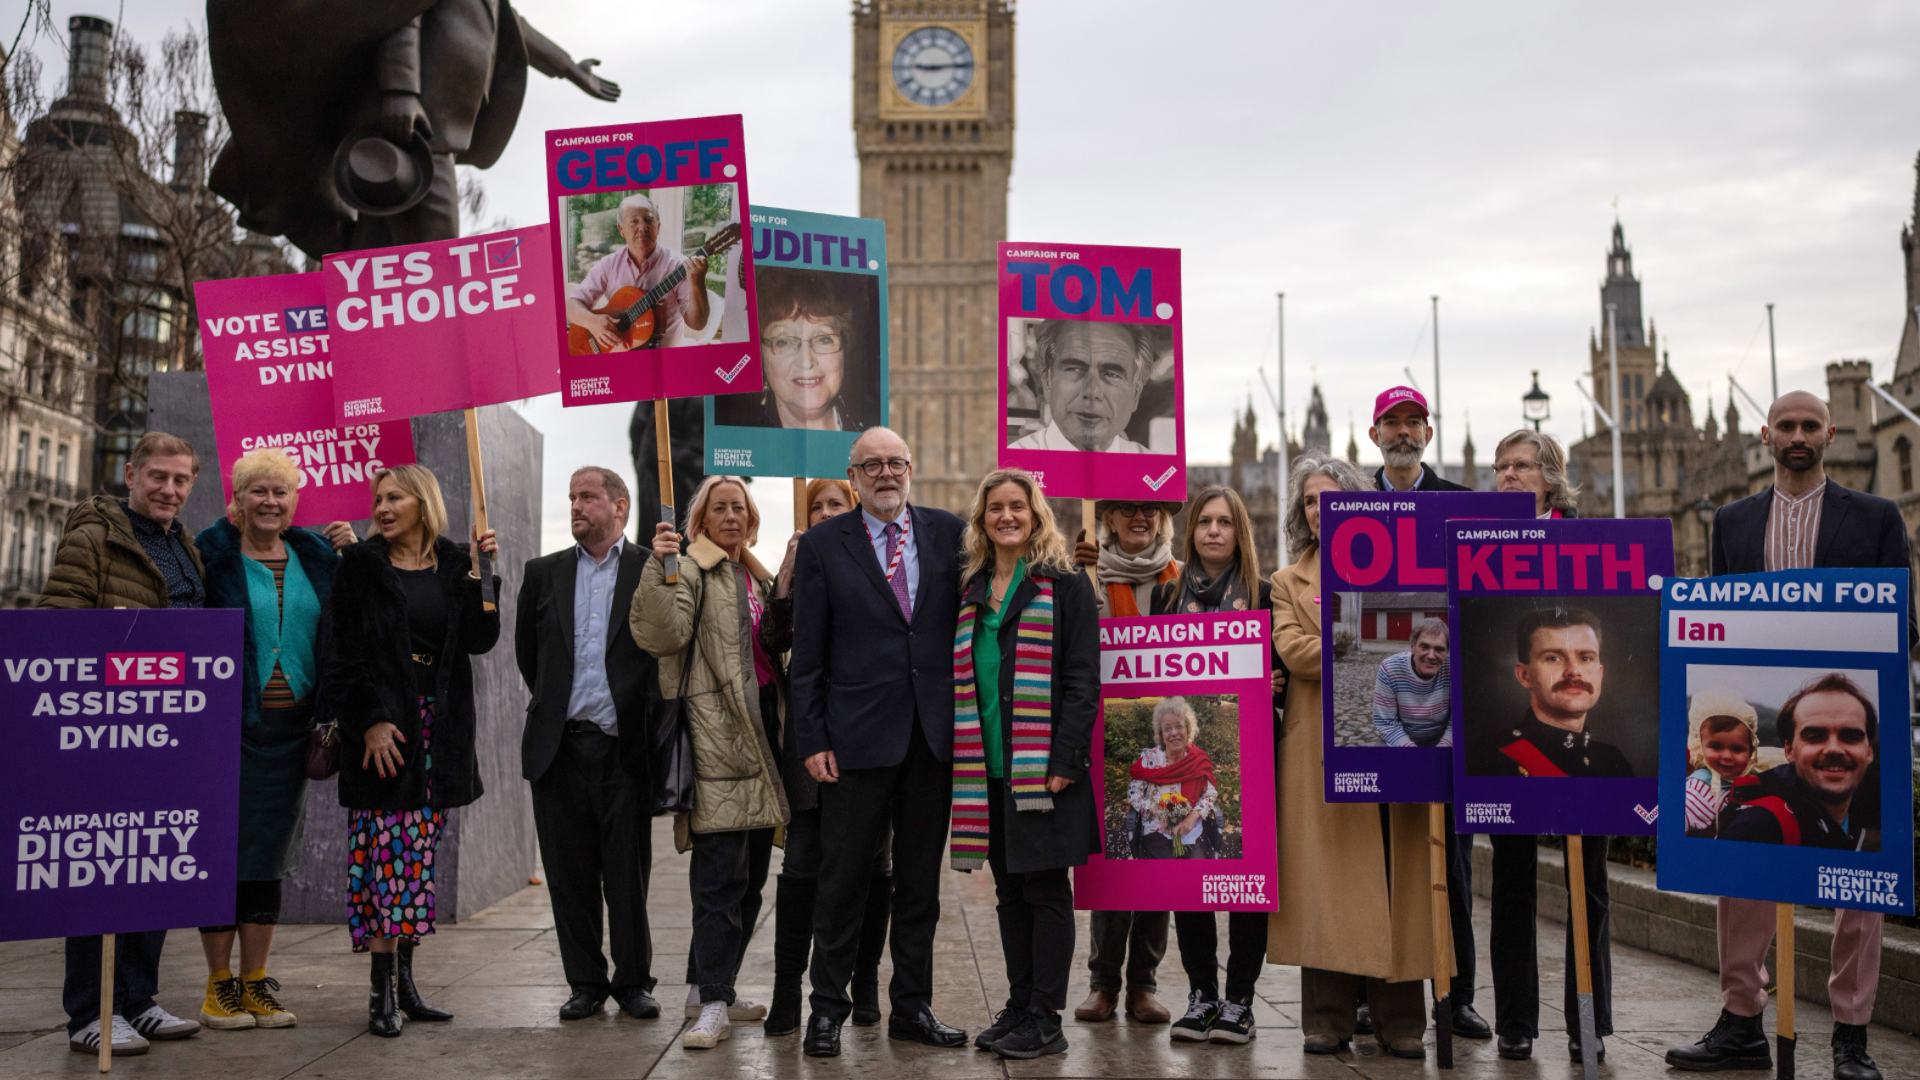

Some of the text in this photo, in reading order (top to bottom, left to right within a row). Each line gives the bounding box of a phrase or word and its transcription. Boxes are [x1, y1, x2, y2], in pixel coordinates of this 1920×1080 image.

[555, 133, 634, 147] CAMPAIGN FOR
[556, 138, 737, 190] GEOFF.
[768, 216, 788, 226] FOR
[1006, 250, 1080, 260] CAMPAIGN FOR
[332, 251, 434, 293] YES
[1006, 261, 1174, 320] TOM.
[336, 274, 536, 332] CHOICE.
[205, 308, 328, 337] VOTE YE
[570, 380, 610, 391] DIGNITY
[571, 387, 614, 398] IN DYING.
[344, 400, 382, 412] DIGNITY
[344, 406, 386, 418] IN DYING.
[241, 424, 381, 450] CAMPAIGN FOR
[242, 437, 382, 468] GNITY
[713, 452, 752, 461] DIGNITY
[724, 460, 755, 468] DYING.
[1330, 502, 1416, 511] CAMPAIGN FOR
[1456, 530, 1546, 540] CAMPAIGN FOR
[1457, 543, 1664, 591] KEITH.
[1671, 582, 1897, 604] CAMPAIGN FOR
[1213, 619, 1262, 640] FOR
[1678, 617, 1726, 641] Ian
[4, 656, 236, 682] VOTE YES TO
[1111, 651, 1230, 680] ALISON
[32, 690, 207, 717] ASSISTED
[59, 724, 179, 750] DYING.
[1334, 776, 1379, 786] DIGNITY
[1334, 785, 1382, 793] IN DYING.
[19, 809, 199, 832] CAMPAIGN FOR
[1465, 807, 1512, 816] DIGNITY
[1466, 815, 1516, 824] IN DYING.
[17, 826, 198, 862] DIGNITY
[16, 855, 209, 891] IN DYING.
[1202, 874, 1266, 882] CAMPAIGN FOR
[1818, 866, 1899, 880] CAMPAIGN FOR
[1818, 873, 1899, 893] DIGNITY
[1202, 881, 1266, 893] DIGNITY
[1818, 886, 1904, 907] IN DYING.
[1203, 892, 1271, 905] IN DYING.
